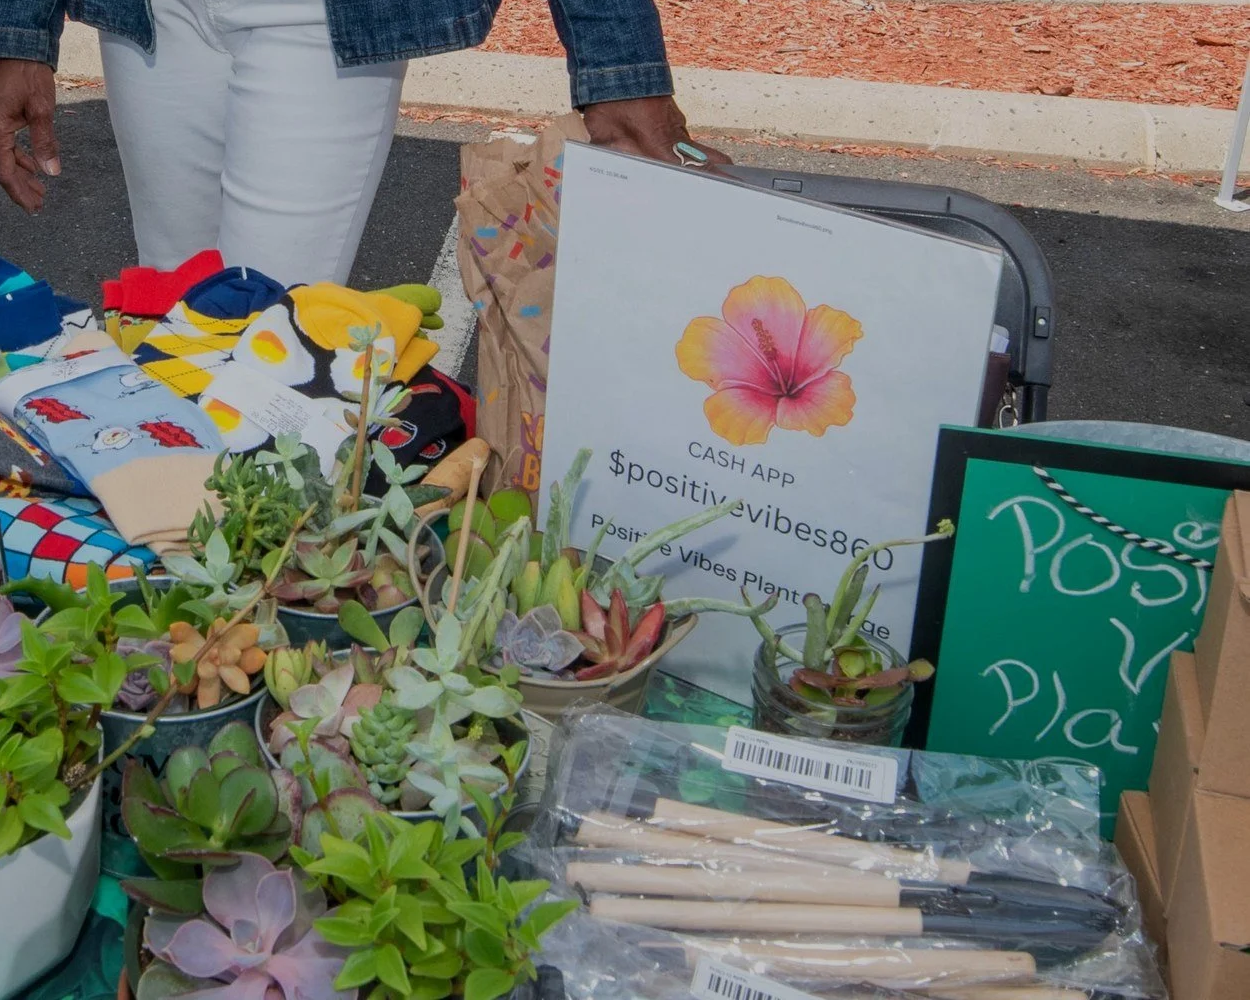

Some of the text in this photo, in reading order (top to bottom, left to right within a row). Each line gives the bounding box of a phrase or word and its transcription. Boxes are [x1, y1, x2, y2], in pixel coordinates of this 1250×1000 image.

[688, 441, 796, 489] CASH APP
[591, 513, 672, 557] Posite
[679, 545, 738, 582] Vibes
[979, 658, 1161, 755] Pla
